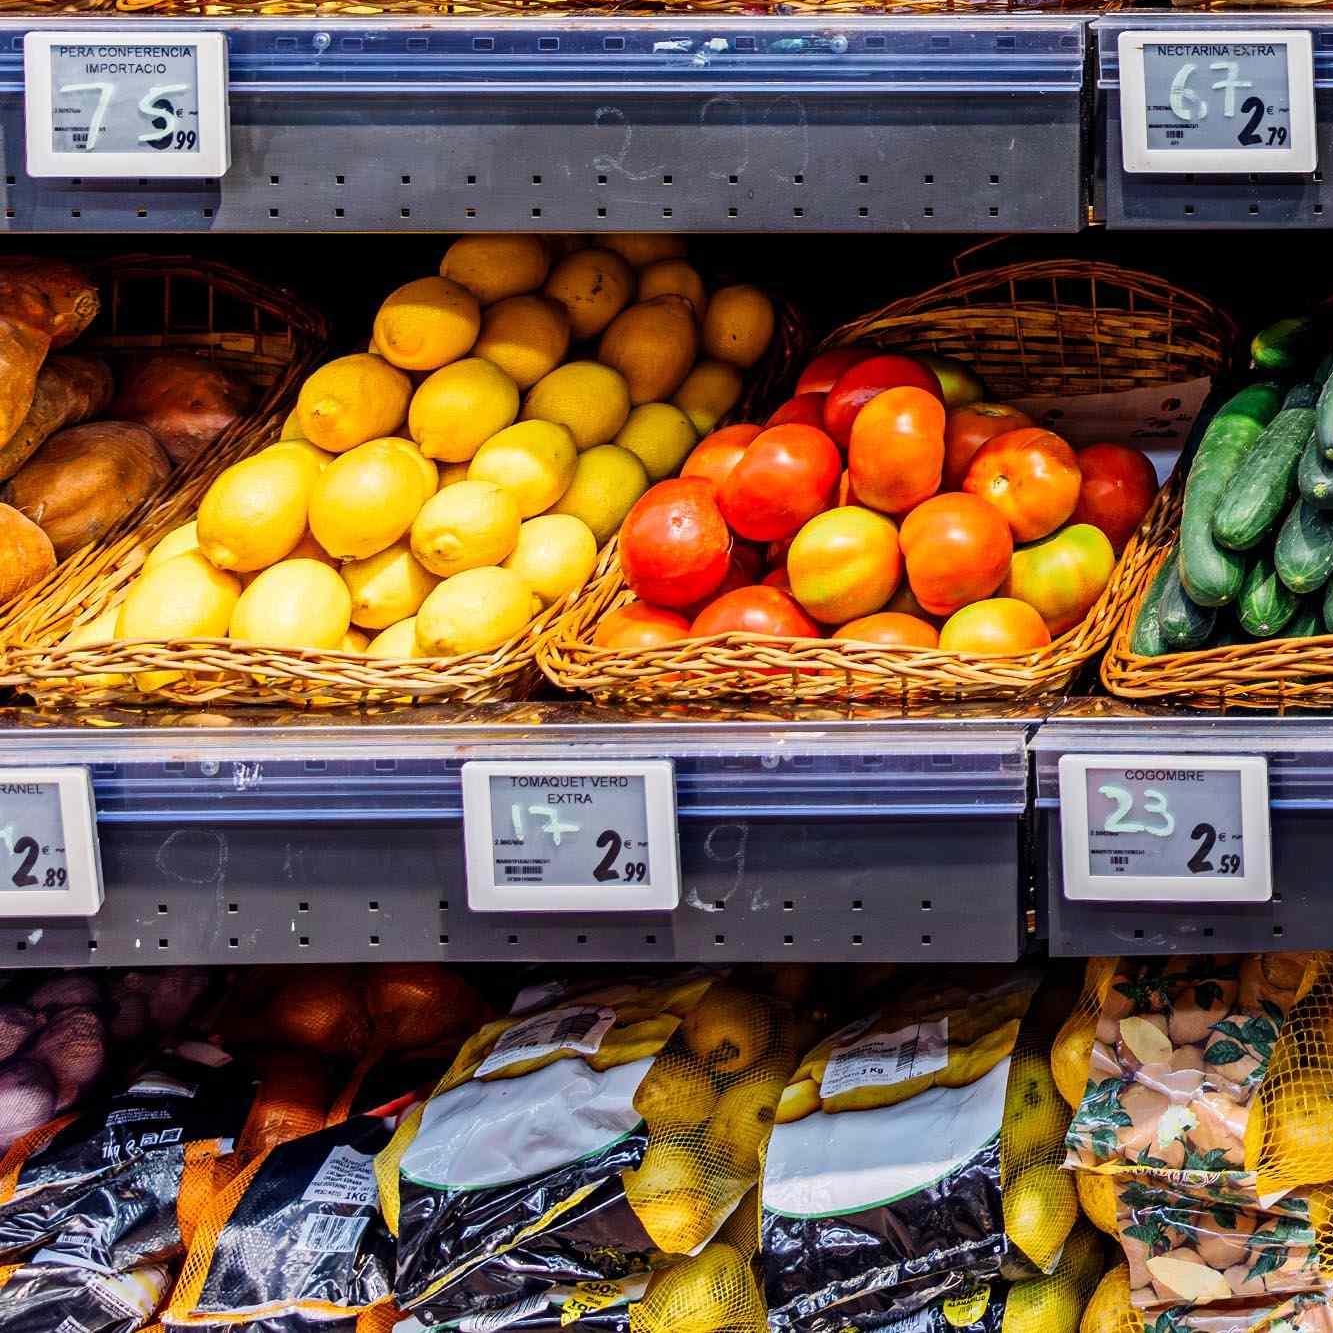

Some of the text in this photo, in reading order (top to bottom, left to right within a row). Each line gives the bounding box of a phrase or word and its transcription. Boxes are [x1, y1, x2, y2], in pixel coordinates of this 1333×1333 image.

[60, 47, 193, 58] PERA CONFERENCIA
[1157, 45, 1276, 57] NECTARINA EXTRA
[1170, 61, 1253, 121] 67
[1125, 769, 1205, 782] COGOMBRE
[510, 776, 629, 788] TOMAQUET VERD
[547, 793, 593, 804] EXTRA
[1098, 785, 1175, 837] 23
[511, 804, 580, 846] 17
